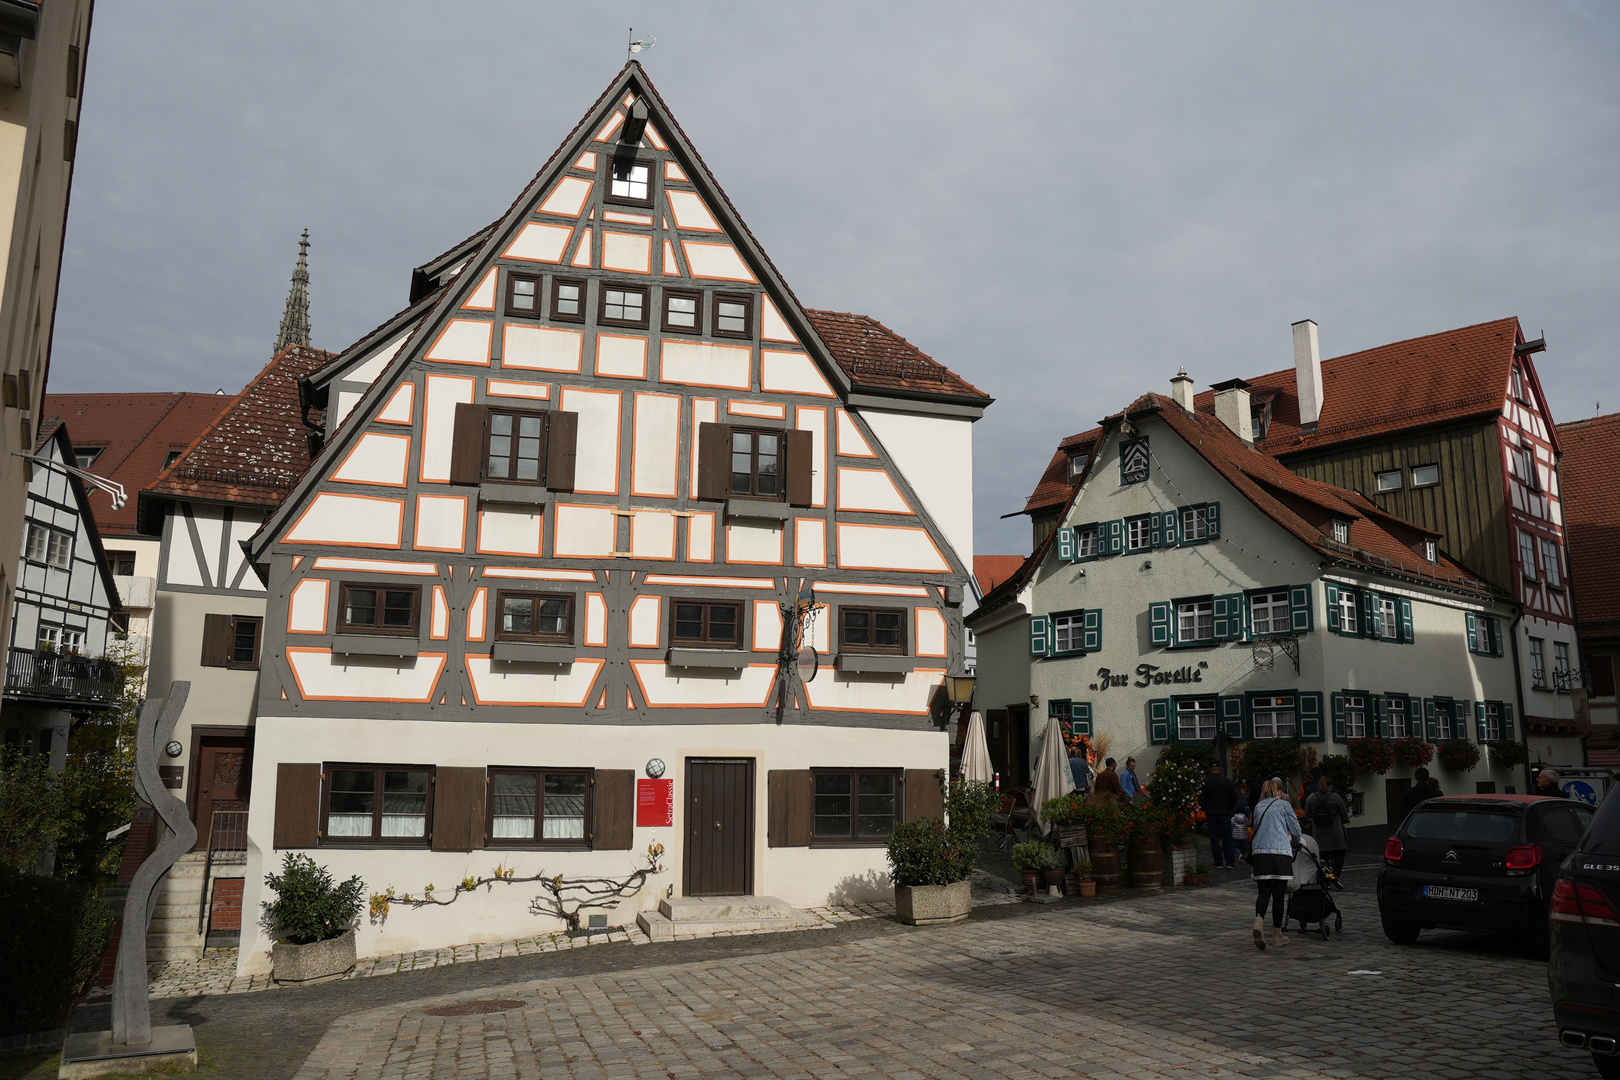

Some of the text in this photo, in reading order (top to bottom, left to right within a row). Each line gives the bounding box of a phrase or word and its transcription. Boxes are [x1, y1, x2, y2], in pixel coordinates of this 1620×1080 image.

[665, 780, 673, 824] SetraClassic
[1583, 863, 1603, 871] GLE
[1428, 886, 1477, 900] HDH NT 203
